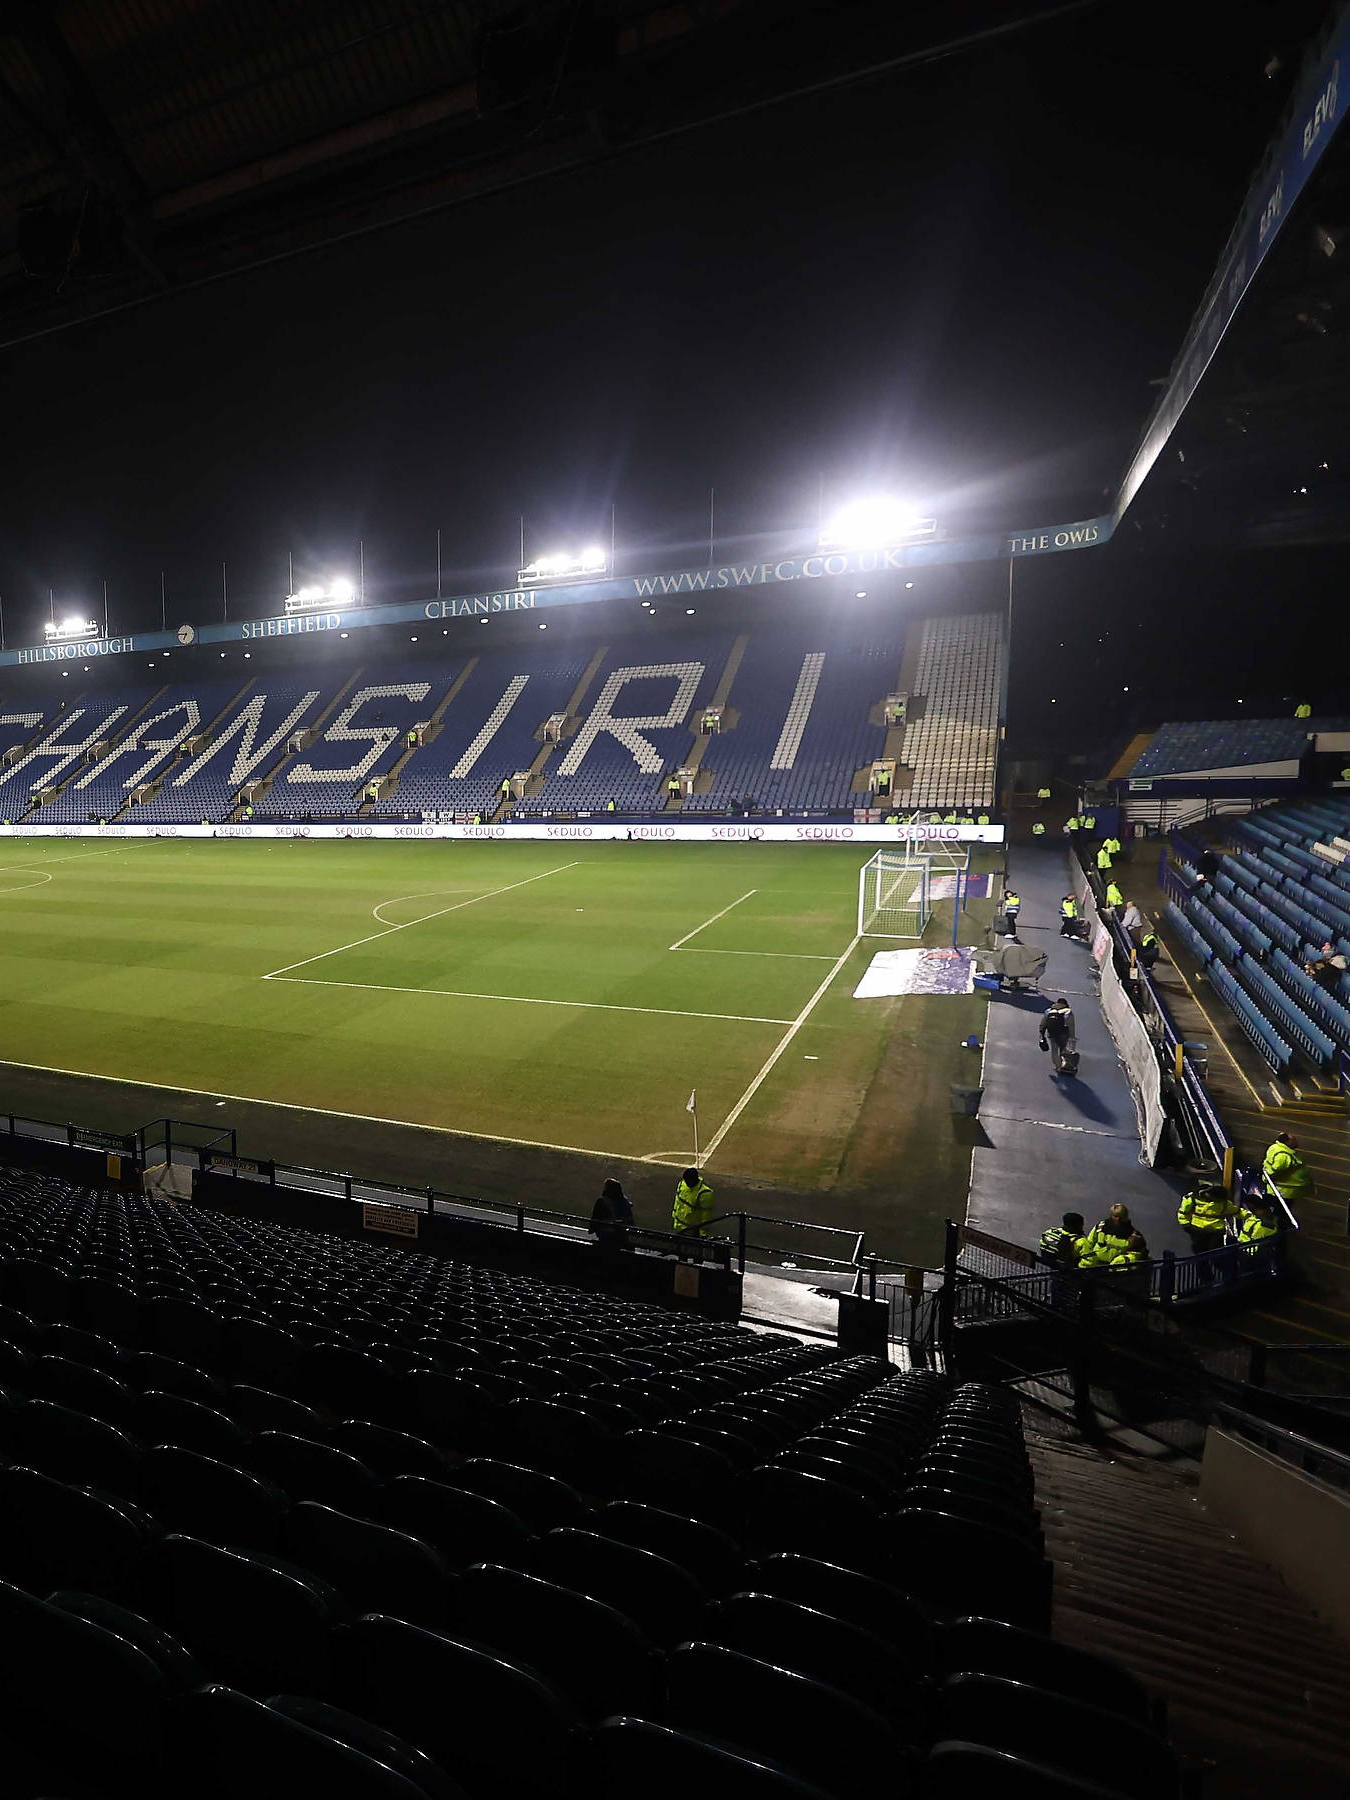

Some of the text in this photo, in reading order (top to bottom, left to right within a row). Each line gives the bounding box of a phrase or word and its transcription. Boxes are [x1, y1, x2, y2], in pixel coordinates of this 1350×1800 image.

[1008, 526, 1098, 552] THE OWLS
[634, 546, 903, 596] WWW.SWFC.CO.UK
[424, 591, 536, 619] CHANSIRI
[242, 613, 340, 638] SHEFFIELD
[18, 638, 134, 664] HILLSBOROUGH
[11, 826, 38, 835] SEDULO
[55, 826, 82, 835] SEDULO
[97, 826, 126, 835] SEDULO
[146, 826, 177, 836] SEDULO
[219, 826, 252, 836] SEDULO
[275, 826, 310, 836] SEDULO
[335, 826, 373, 836] SEDULO
[394, 826, 434, 836] SEDULO
[463, 827, 505, 836] SEDULO
[547, 827, 593, 837] SEDULO
[626, 827, 675, 838] SEDULO
[712, 827, 765, 838] SEDULO
[797, 827, 853, 839] SEDULO
[897, 827, 959, 840] SEDULO
